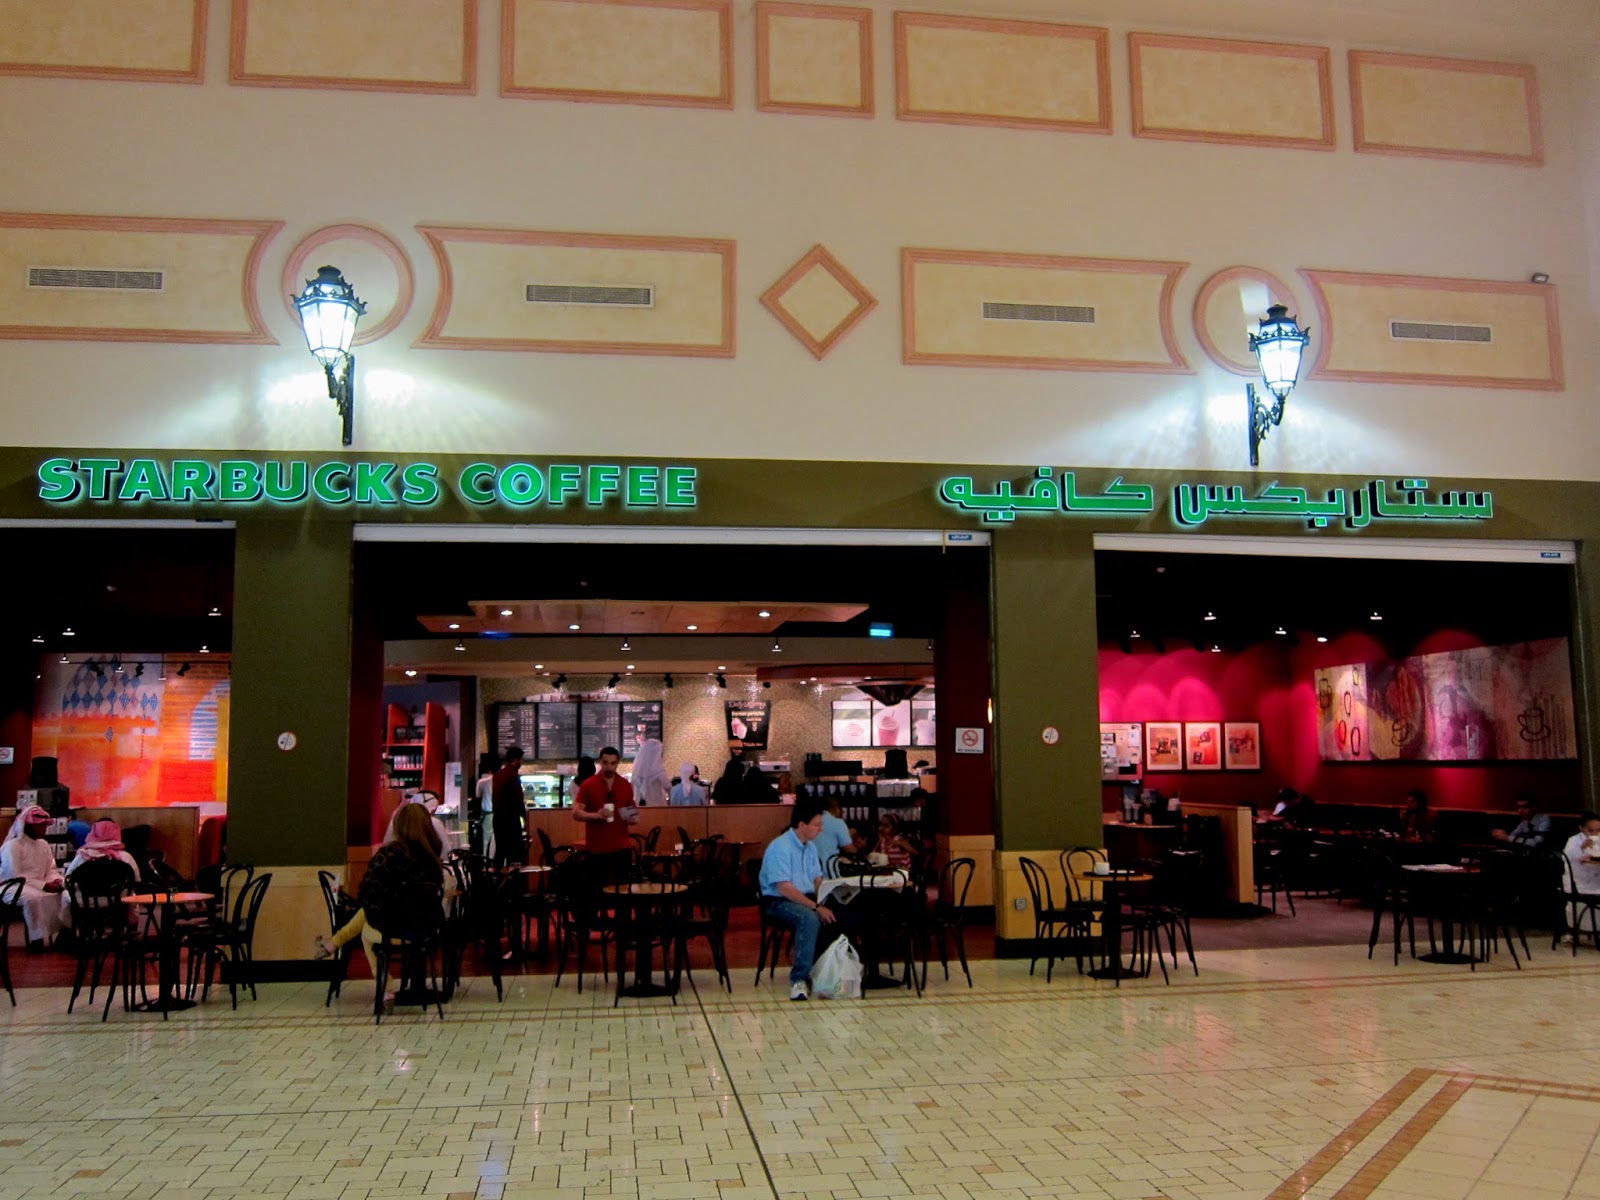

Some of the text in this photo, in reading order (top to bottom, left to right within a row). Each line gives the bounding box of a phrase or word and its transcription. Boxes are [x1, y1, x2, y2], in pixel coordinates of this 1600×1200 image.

[38, 457, 697, 506] STARBUCKS COFFEE
[941, 466, 1493, 528] ستاربكس كافيه
